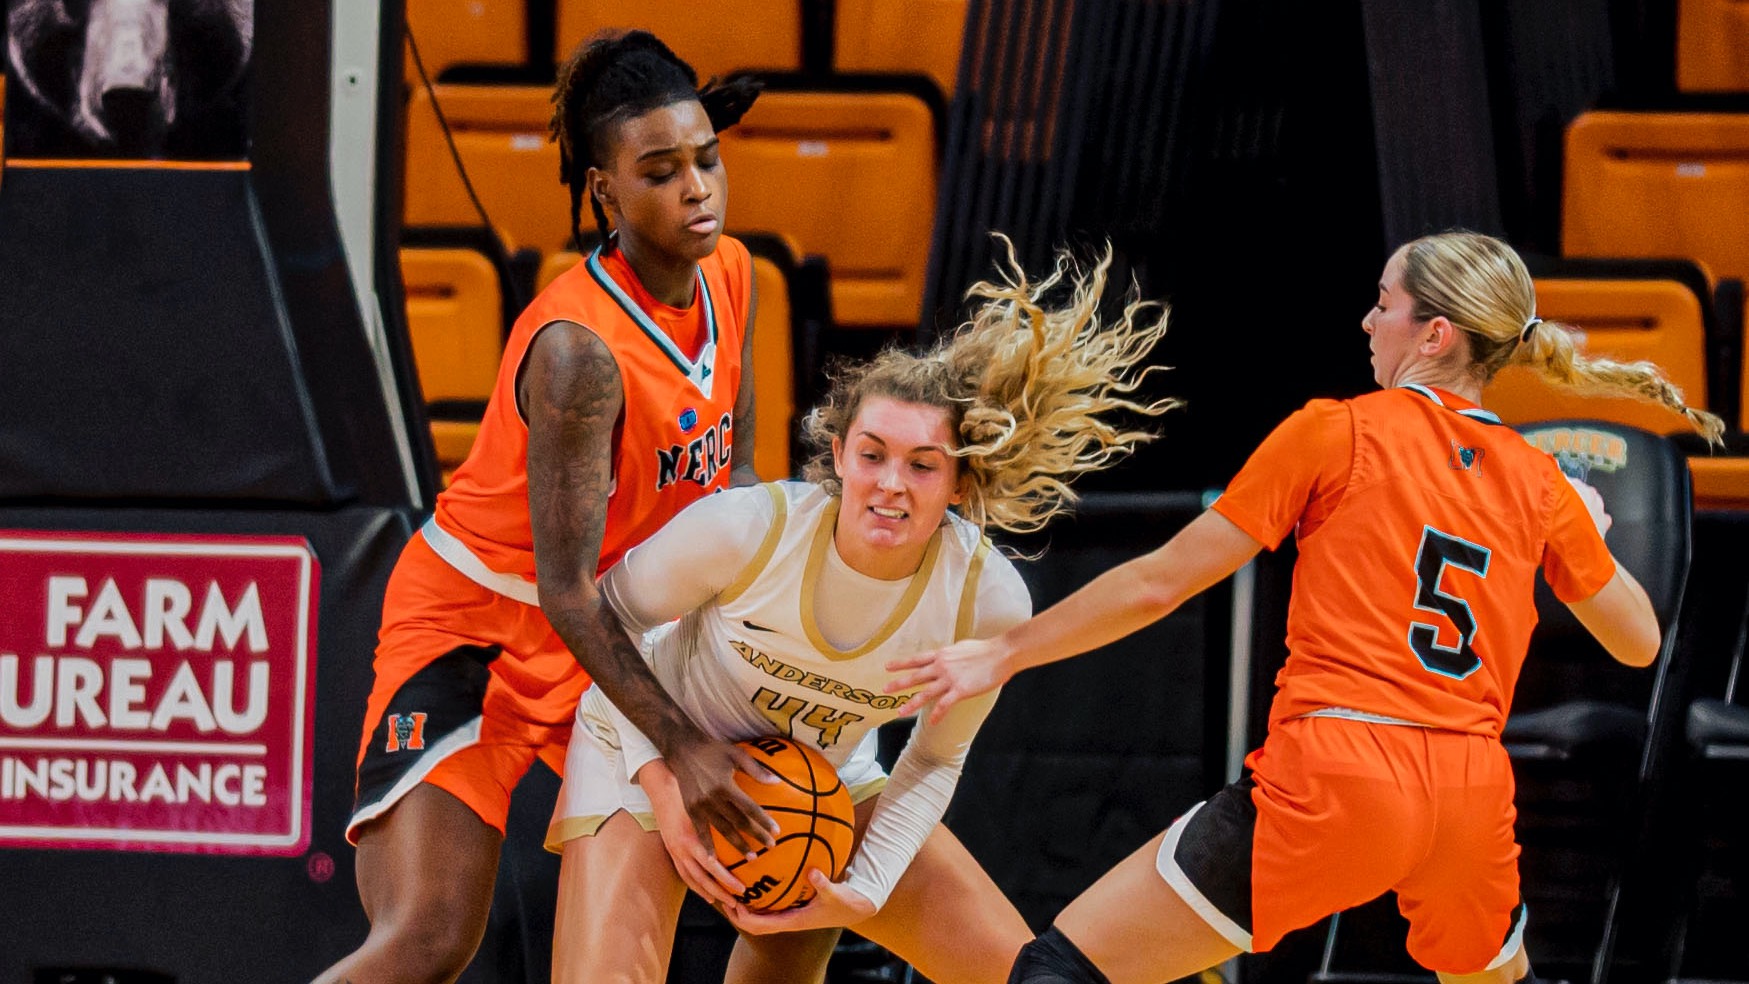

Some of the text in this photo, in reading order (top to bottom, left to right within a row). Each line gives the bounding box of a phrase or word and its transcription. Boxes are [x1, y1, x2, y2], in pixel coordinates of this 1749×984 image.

[46, 576, 269, 652] FARM
[1408, 525, 1491, 680] 5
[0, 655, 269, 734] UREAU
[751, 686, 864, 750] 44
[1, 758, 267, 806] INSURANCE
